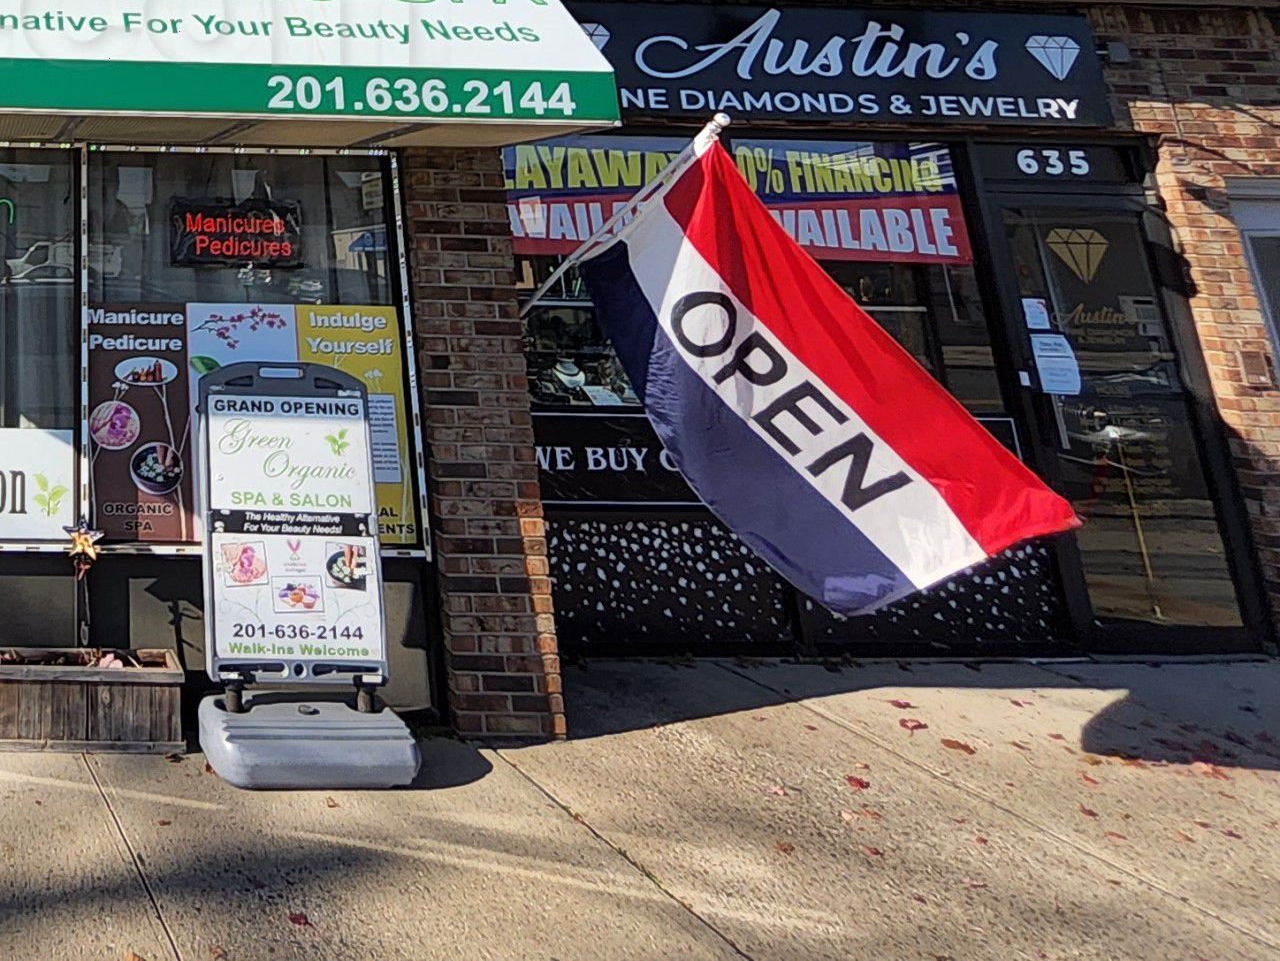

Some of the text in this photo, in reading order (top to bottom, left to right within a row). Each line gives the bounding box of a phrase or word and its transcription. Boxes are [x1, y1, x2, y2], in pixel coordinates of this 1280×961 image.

[122, 12, 183, 35] For
[191, 14, 273, 37] Your
[283, 16, 411, 44] Beauty
[420, 19, 541, 44] Needs
[634, 7, 1000, 81] Austin's
[266, 75, 577, 116] 201.636.2144
[620, 87, 1079, 120] NE DIAMONDS & JEWELRY
[785, 150, 944, 193] FINANCING
[1016, 149, 1091, 175] 635
[185, 211, 286, 234] Manicures
[770, 208, 959, 257] VAILABLE
[195, 235, 292, 257] Pedicures
[88, 308, 184, 325] Manicure
[308, 310, 387, 332] Indulge
[89, 333, 183, 351] Pedicure
[306, 336, 393, 354] Yourself
[213, 399, 275, 414] GRAND
[280, 401, 360, 416] OPENING
[670, 290, 914, 514] OPEN
[218, 417, 294, 455] Green
[263, 449, 356, 490] Organic
[584, 446, 648, 472] BUY
[103, 503, 173, 515] ORGANIC
[230, 491, 352, 509] SPA & SALON
[245, 511, 341, 524] The Healthy Alternative
[378, 506, 399, 518] AL
[124, 520, 153, 532] SPA
[243, 522, 259, 532] For
[261, 523, 280, 533] Your
[281, 523, 312, 535] Beauty
[378, 523, 416, 535] ENTS
[232, 623, 364, 640] 201-636-2144
[228, 642, 370, 657] Walk-Ins Welcome
